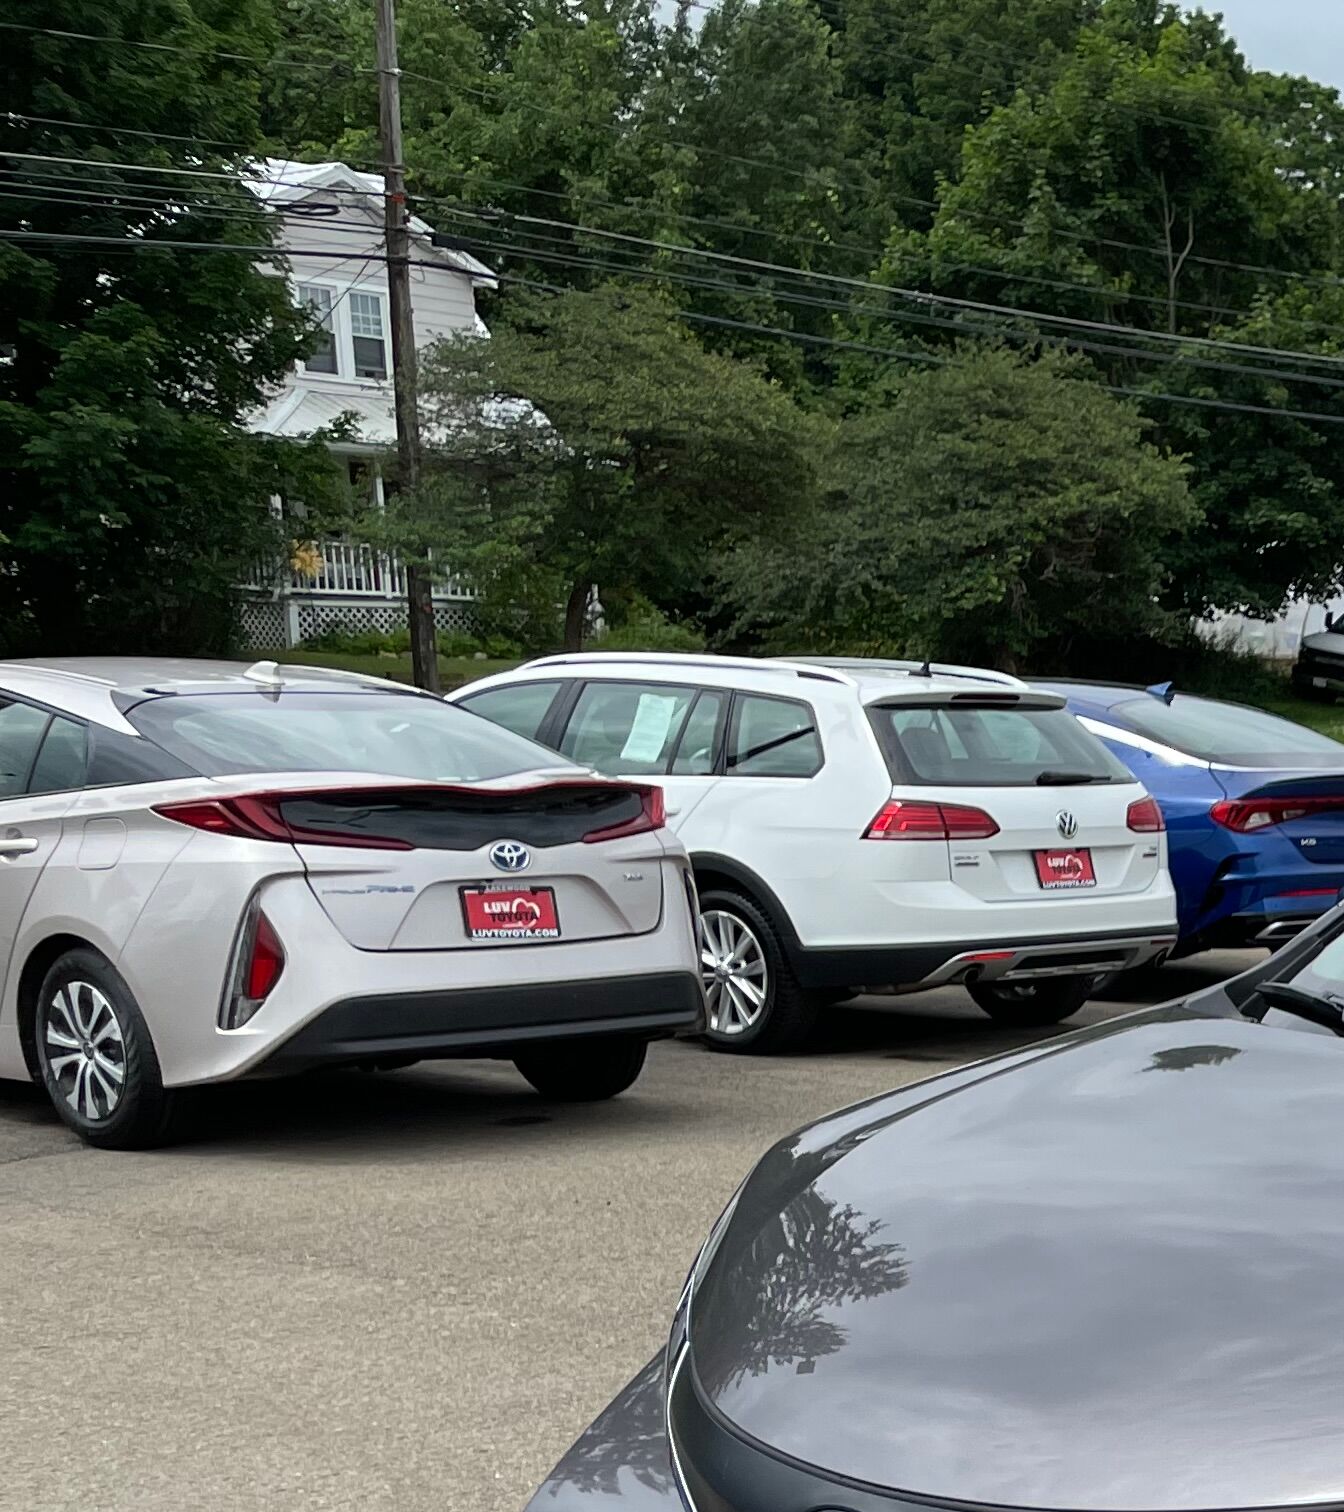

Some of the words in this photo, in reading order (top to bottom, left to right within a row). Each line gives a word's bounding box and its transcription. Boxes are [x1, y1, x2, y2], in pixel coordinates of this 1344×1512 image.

[484, 901, 510, 913] LUV
[490, 911, 538, 922] TOYOTA
[472, 928, 558, 938] LUVTOYOTA.COM
